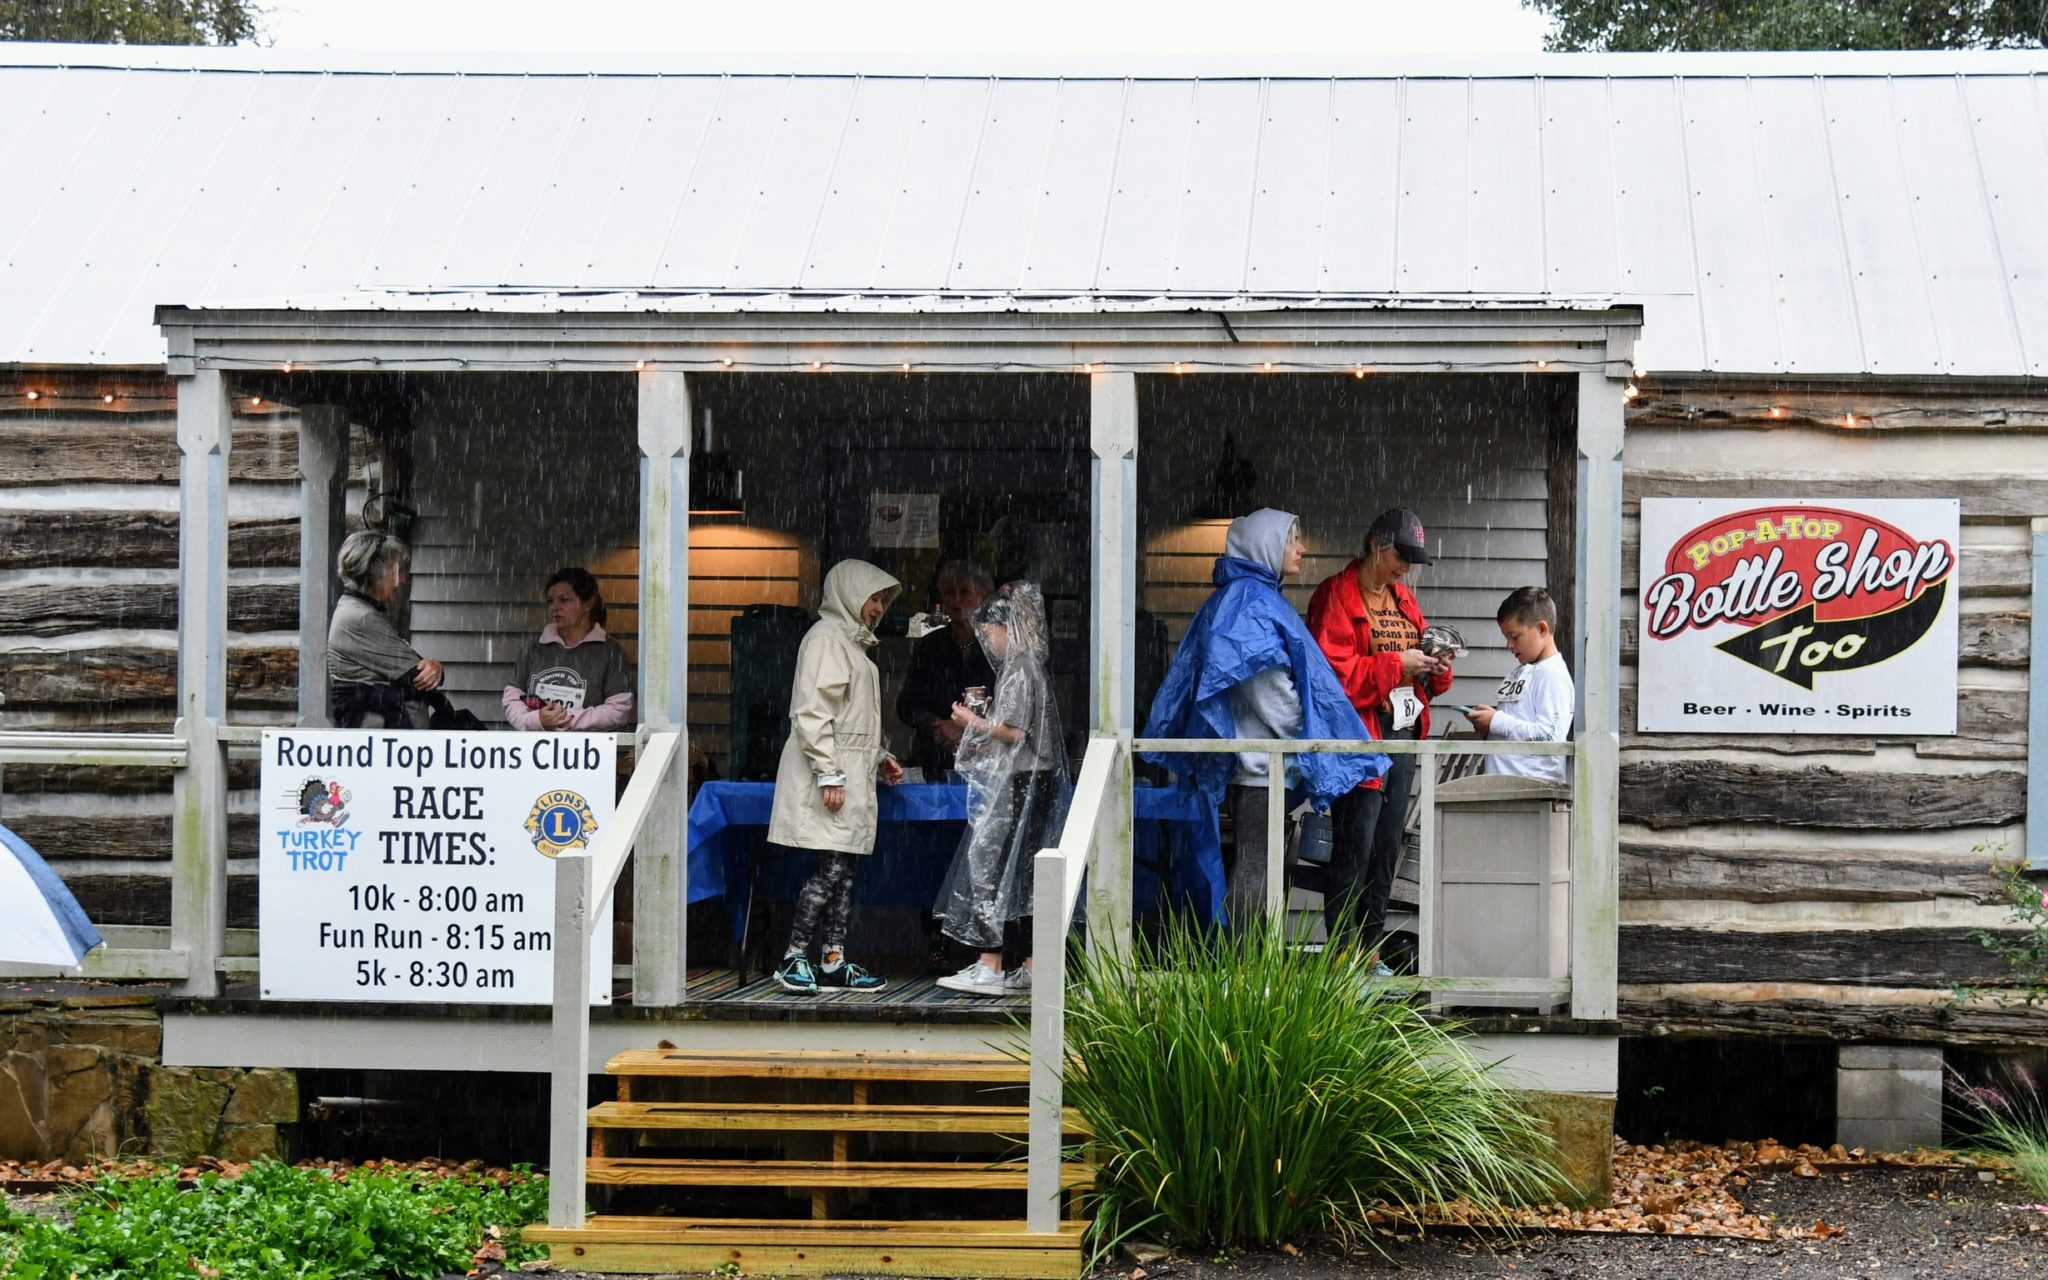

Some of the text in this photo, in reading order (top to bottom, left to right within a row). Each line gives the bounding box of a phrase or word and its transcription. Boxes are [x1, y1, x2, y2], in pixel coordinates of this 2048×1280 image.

[1648, 527, 1950, 636] Bottle Shop
[1370, 628, 1402, 639] beans
[1760, 624, 1868, 674] Too
[1403, 698, 1415, 717] 87
[1683, 702, 1737, 715] Beer
[1758, 703, 1816, 716] Wine
[1836, 704, 1912, 720] Spirits
[277, 736, 601, 777] Round Top Lions Club
[392, 786, 484, 820] RACE
[540, 792, 582, 808] LIONS
[553, 812, 571, 836] L
[276, 828, 362, 851] TURKEY
[379, 831, 495, 866] TIMES:
[287, 850, 348, 872] TROT
[348, 884, 396, 911] 10k
[418, 886, 477, 912] 8:00
[485, 892, 524, 913] am
[320, 922, 364, 949] Fun
[374, 922, 422, 949] Run
[446, 924, 505, 951] 8:15
[513, 931, 551, 951] am
[356, 959, 387, 987] 5k
[409, 961, 468, 988] 8:30
[476, 968, 514, 988] am
